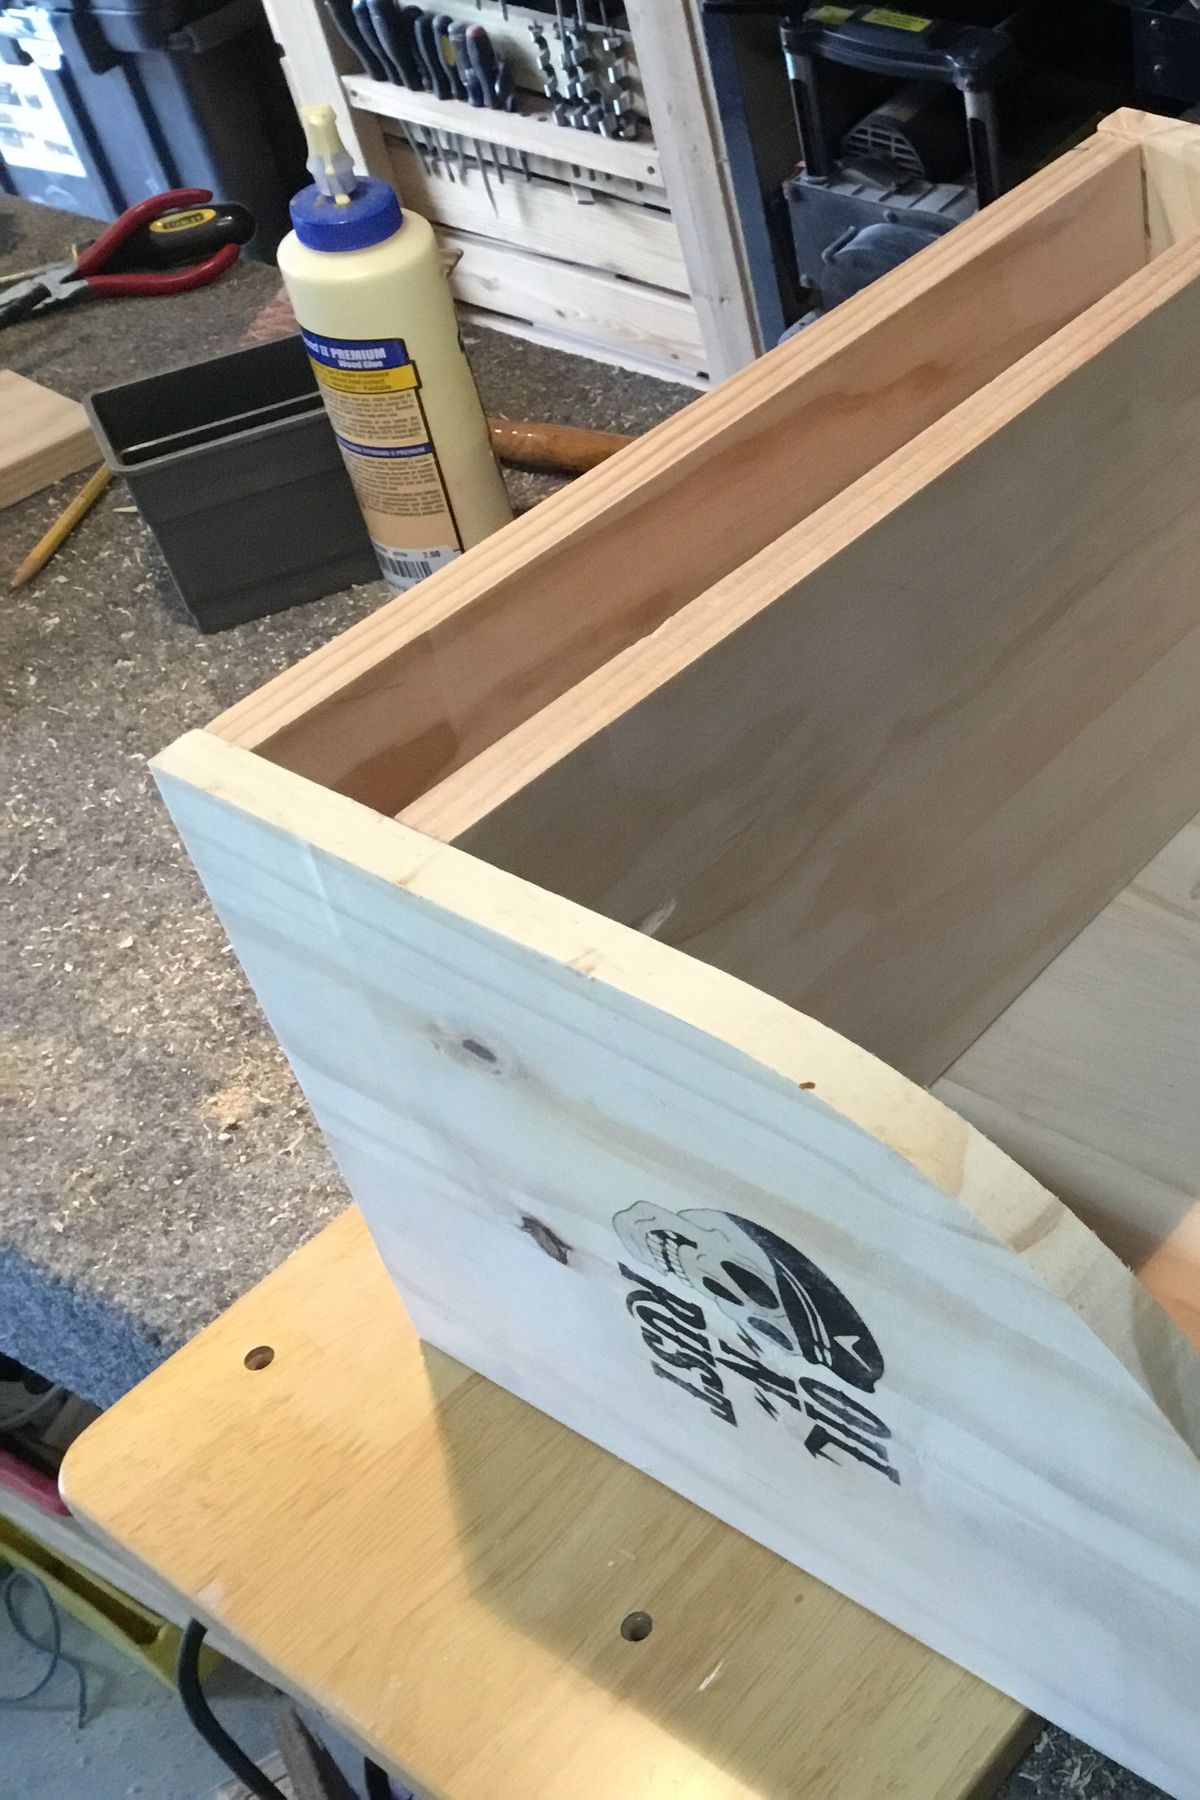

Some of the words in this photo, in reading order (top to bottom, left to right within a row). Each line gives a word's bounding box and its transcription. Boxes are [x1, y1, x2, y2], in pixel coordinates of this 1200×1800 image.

[330, 347, 387, 360] PREMIUM
[618, 1261, 738, 1428] RUST
[799, 1376, 901, 1486] OIL
